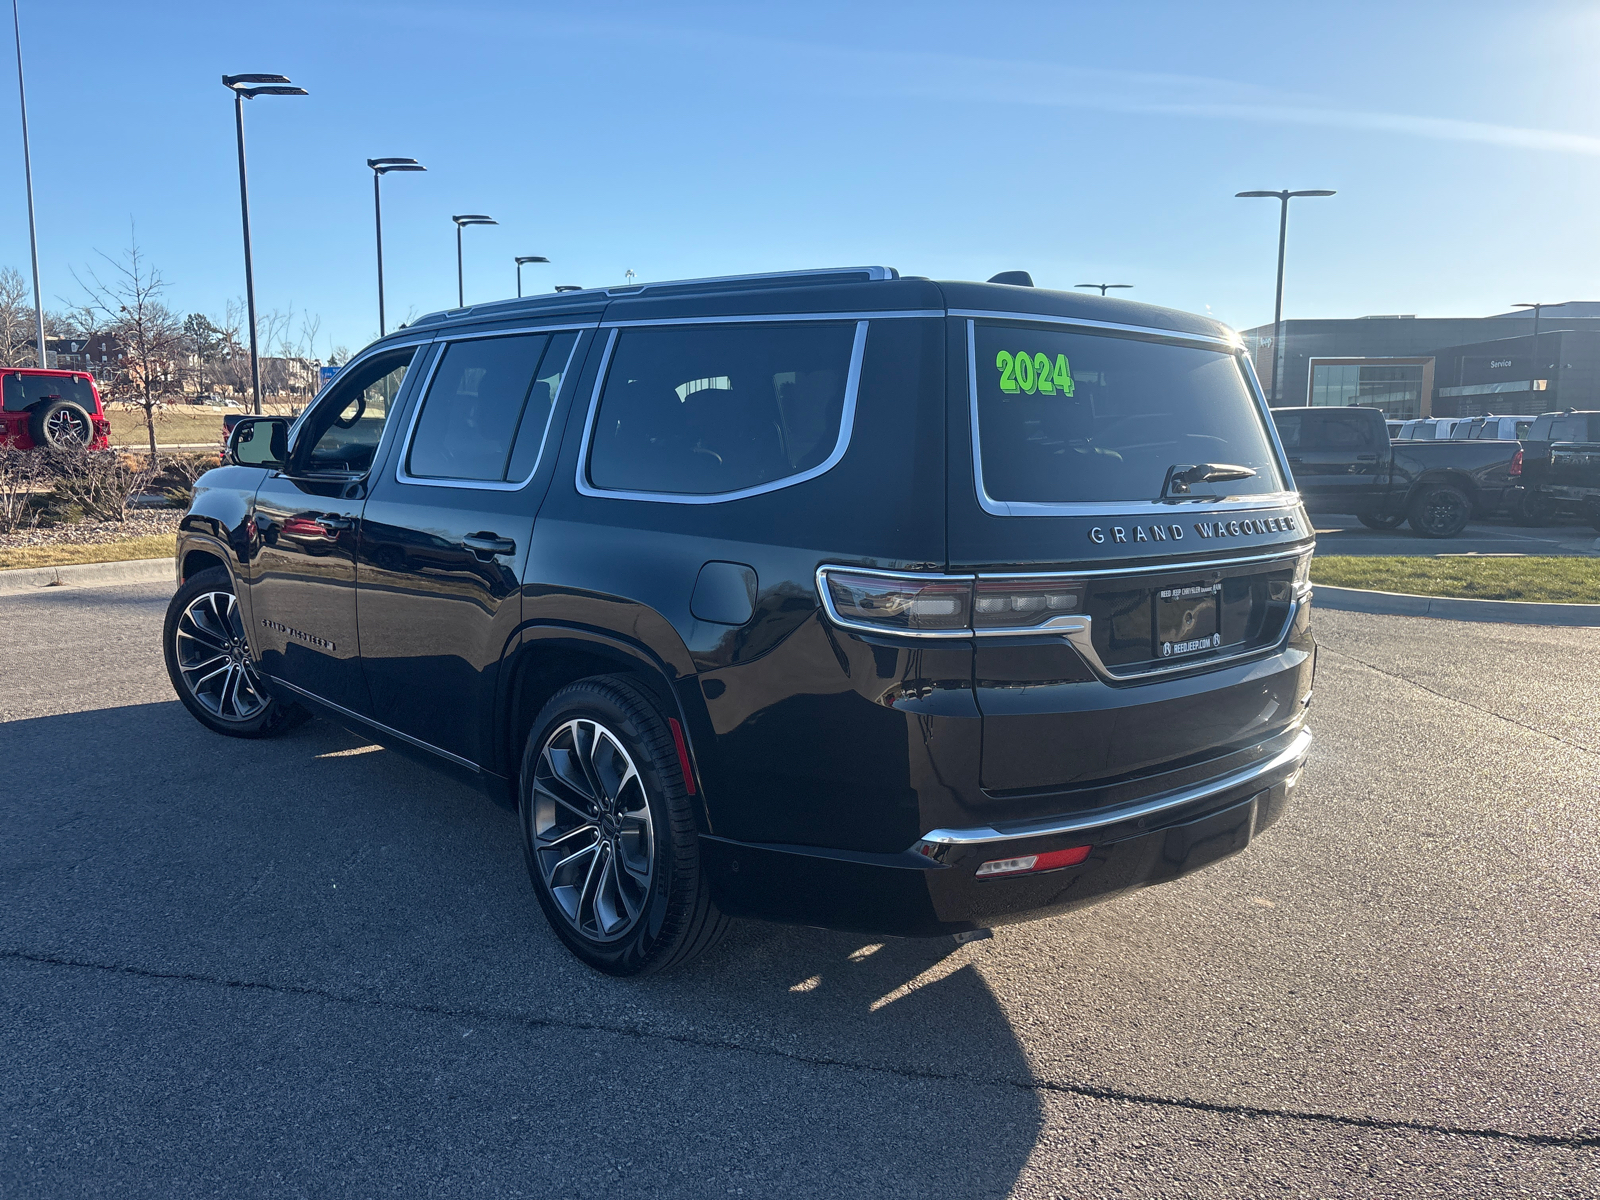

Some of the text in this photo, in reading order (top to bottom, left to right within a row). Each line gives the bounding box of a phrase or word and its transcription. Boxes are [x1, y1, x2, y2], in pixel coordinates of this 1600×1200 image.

[1490, 359, 1512, 369] Service
[996, 350, 1075, 397] 2024
[1088, 515, 1296, 544] GRAND WAGONEER
[1160, 590, 1171, 598] REED
[1172, 588, 1181, 597] JEEP
[1174, 639, 1211, 653] REEDJEEP.COM
